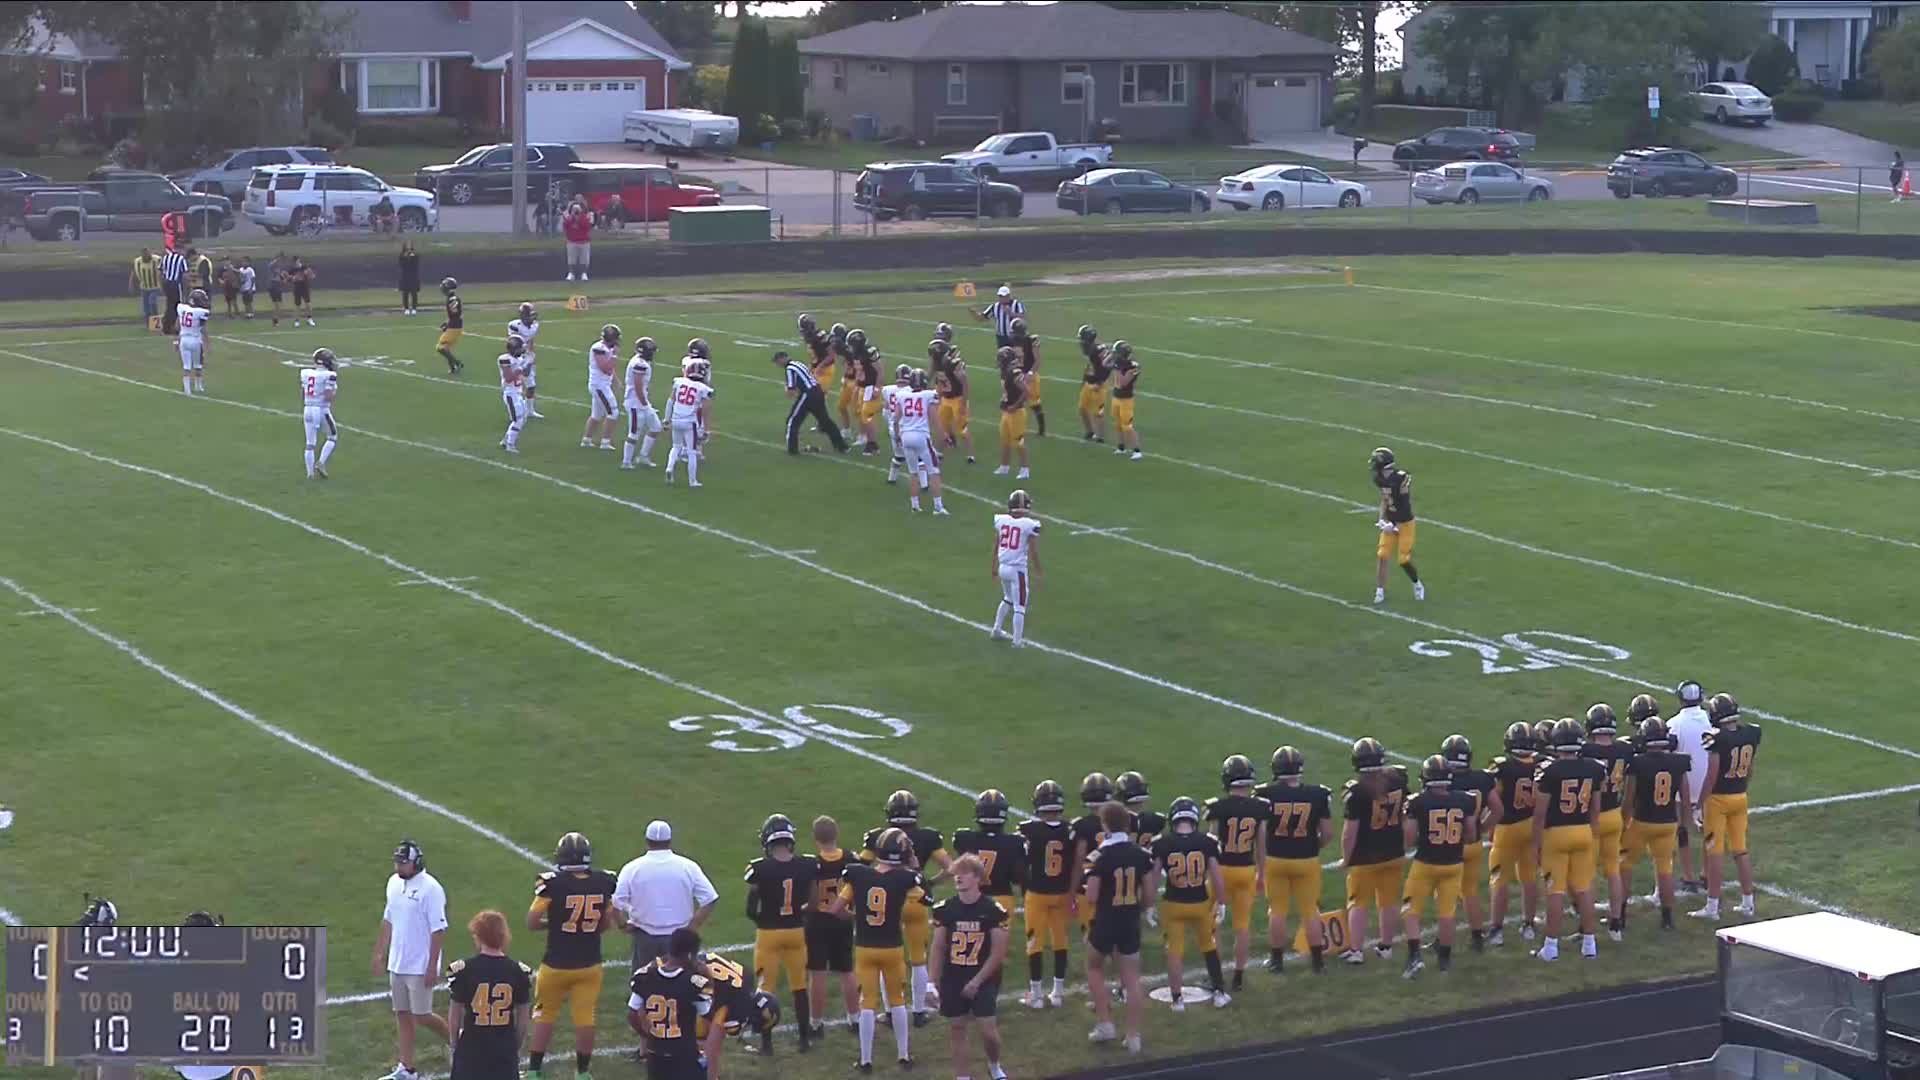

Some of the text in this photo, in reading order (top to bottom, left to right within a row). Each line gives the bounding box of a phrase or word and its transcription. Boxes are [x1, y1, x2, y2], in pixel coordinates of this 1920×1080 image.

[180, 311, 194, 328] 16
[307, 376, 316, 397] 2
[677, 384, 698, 406] 26
[903, 398, 924, 418] 24
[1000, 524, 1021, 550] 20
[1408, 630, 1631, 674] 20
[669, 703, 912, 752] 30
[1559, 777, 1593, 814] 54
[1654, 771, 1672, 806] 8
[1225, 817, 1257, 854] 12
[1273, 802, 1312, 838] 77
[1428, 807, 1466, 845] 56
[1044, 840, 1063, 877] 6
[1167, 850, 1206, 888] 20
[780, 878, 793, 916] 1
[1112, 866, 1137, 906] 11
[561, 894, 604, 933] 75
[866, 886, 888, 926] 9
[951, 931, 985, 966] 27
[470, 983, 513, 1026] 42
[646, 994, 682, 1039] 21
